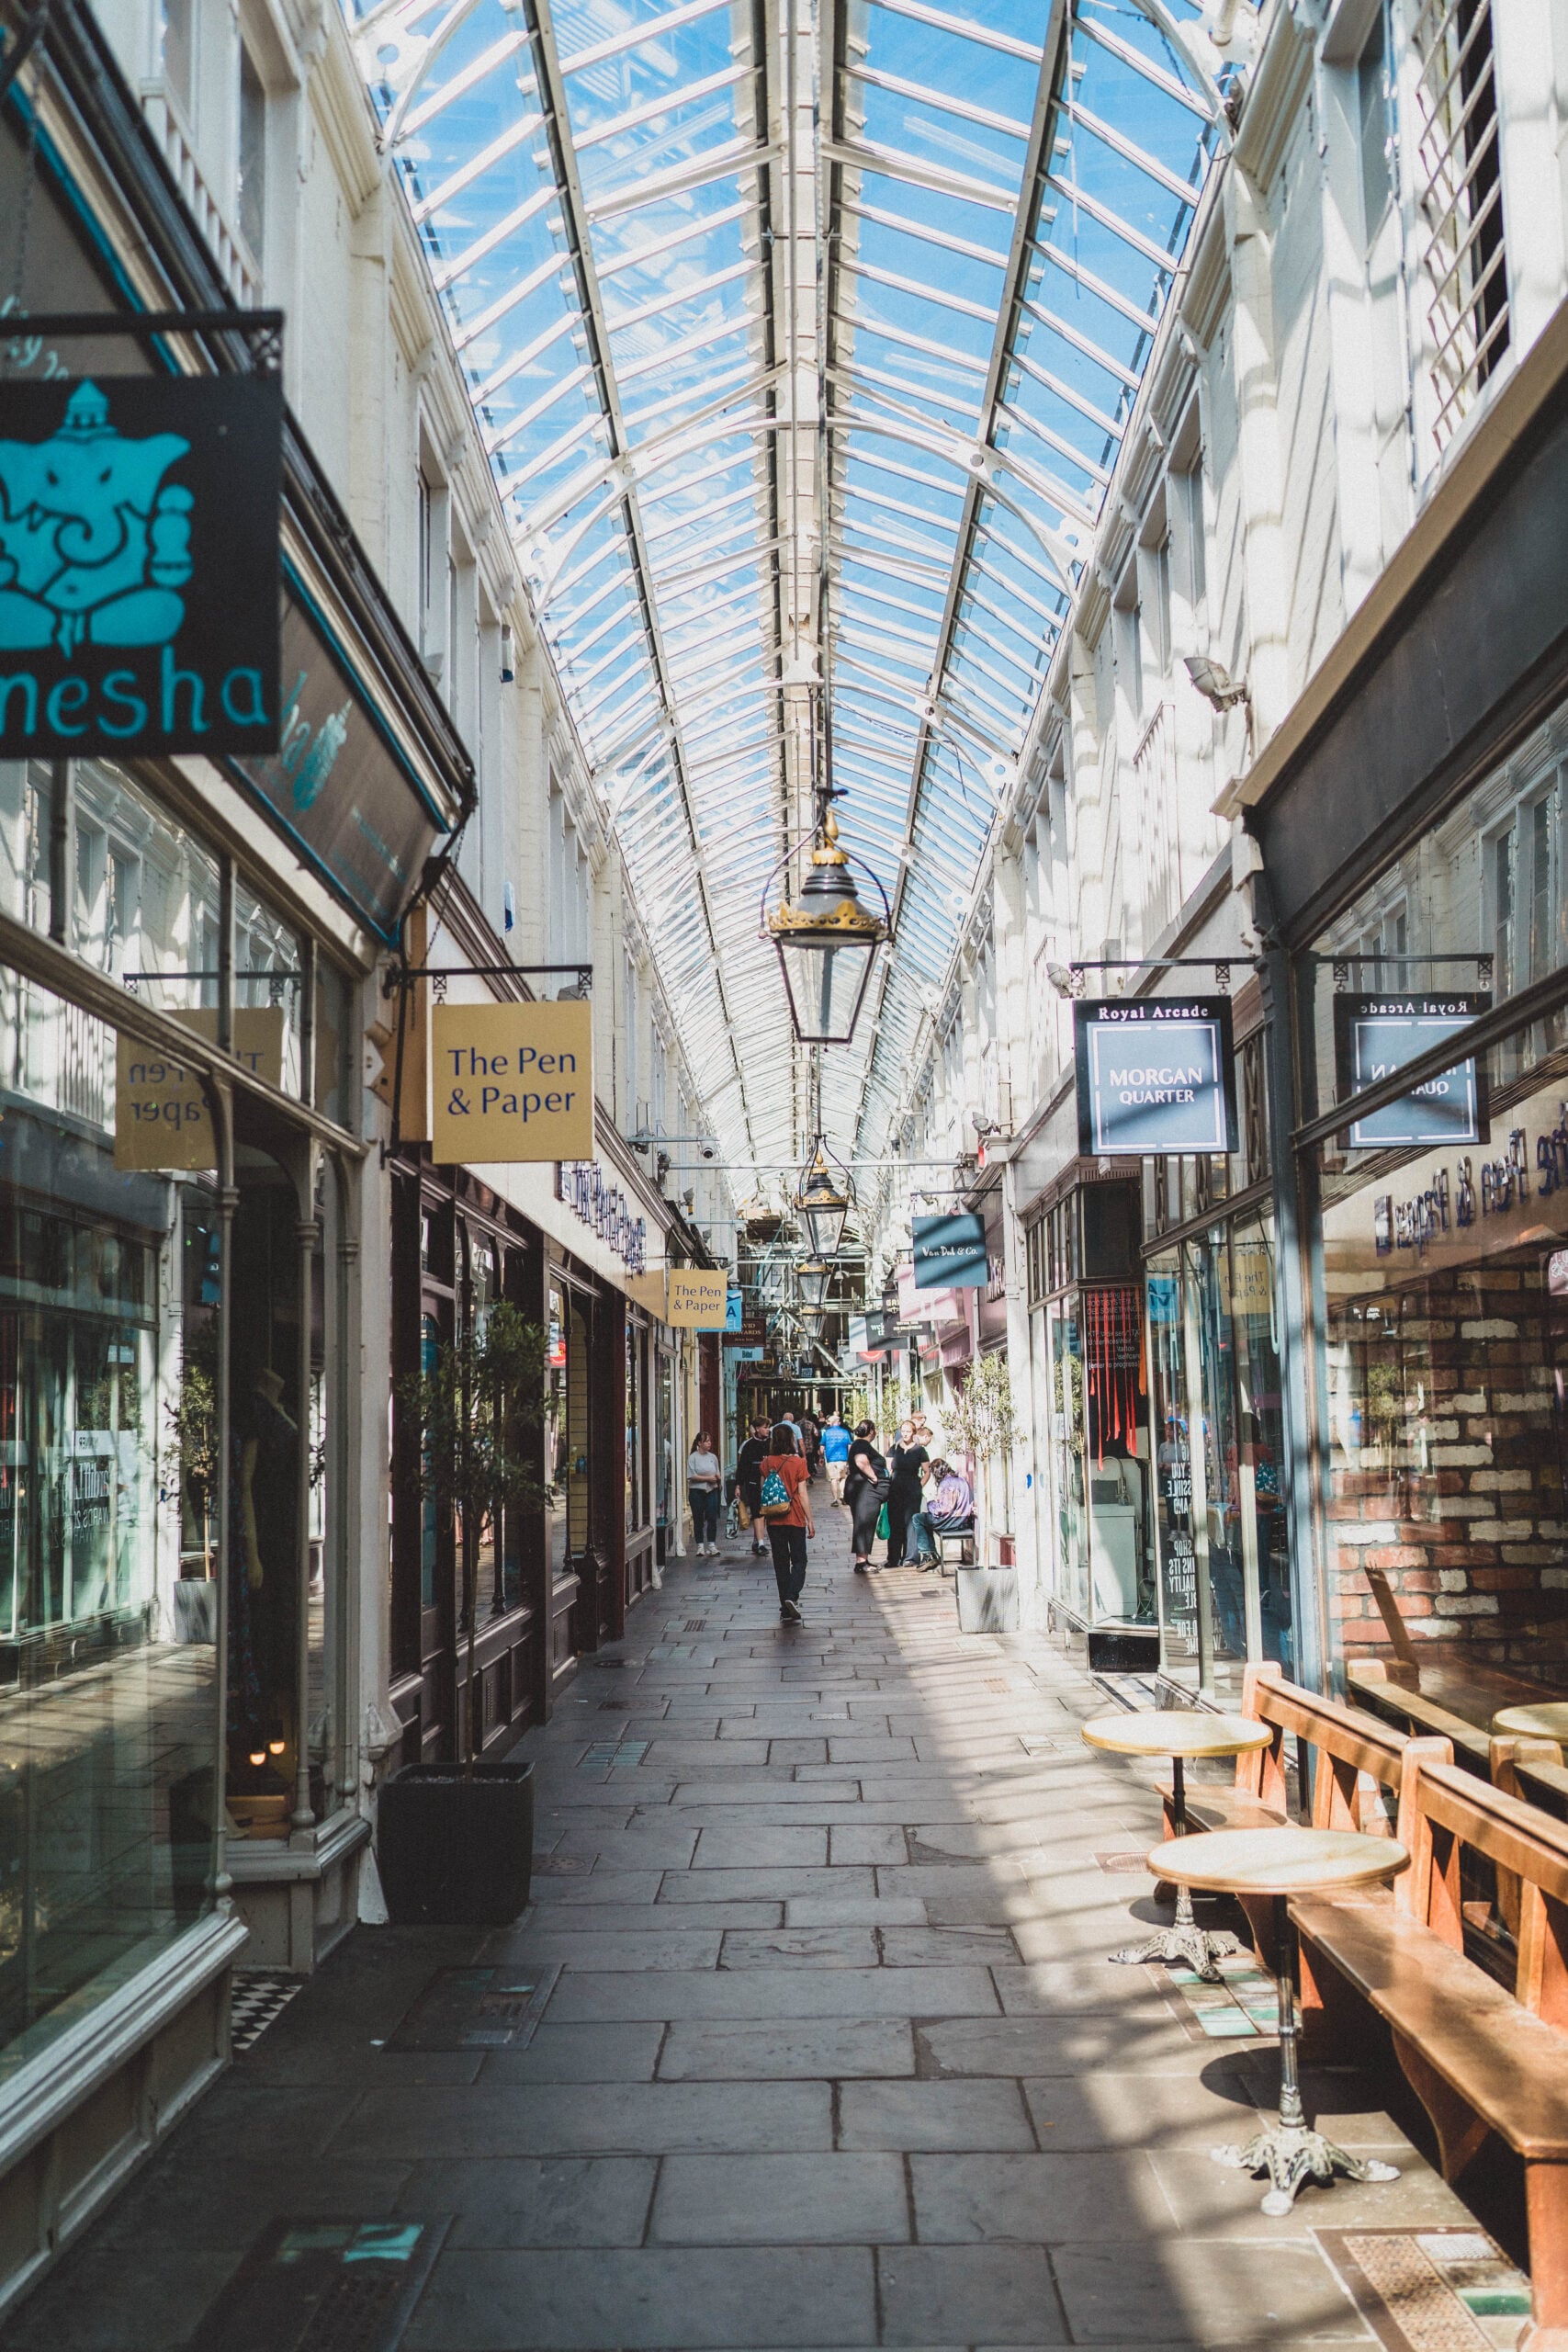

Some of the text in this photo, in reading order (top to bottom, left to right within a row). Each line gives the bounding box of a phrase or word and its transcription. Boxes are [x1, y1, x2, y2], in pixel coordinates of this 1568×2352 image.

[0, 643, 271, 739] nesha
[1099, 1005, 1209, 1022] Royal Arcade
[447, 1046, 576, 1076] The Pen
[1110, 1068, 1202, 1086] MORGAN
[447, 1086, 576, 1123] & Paper
[1119, 1089, 1195, 1105] QUARTER
[674, 1284, 721, 1297] The Pen
[673, 1299, 682, 1310] &
[685, 1299, 721, 1314] Paper
